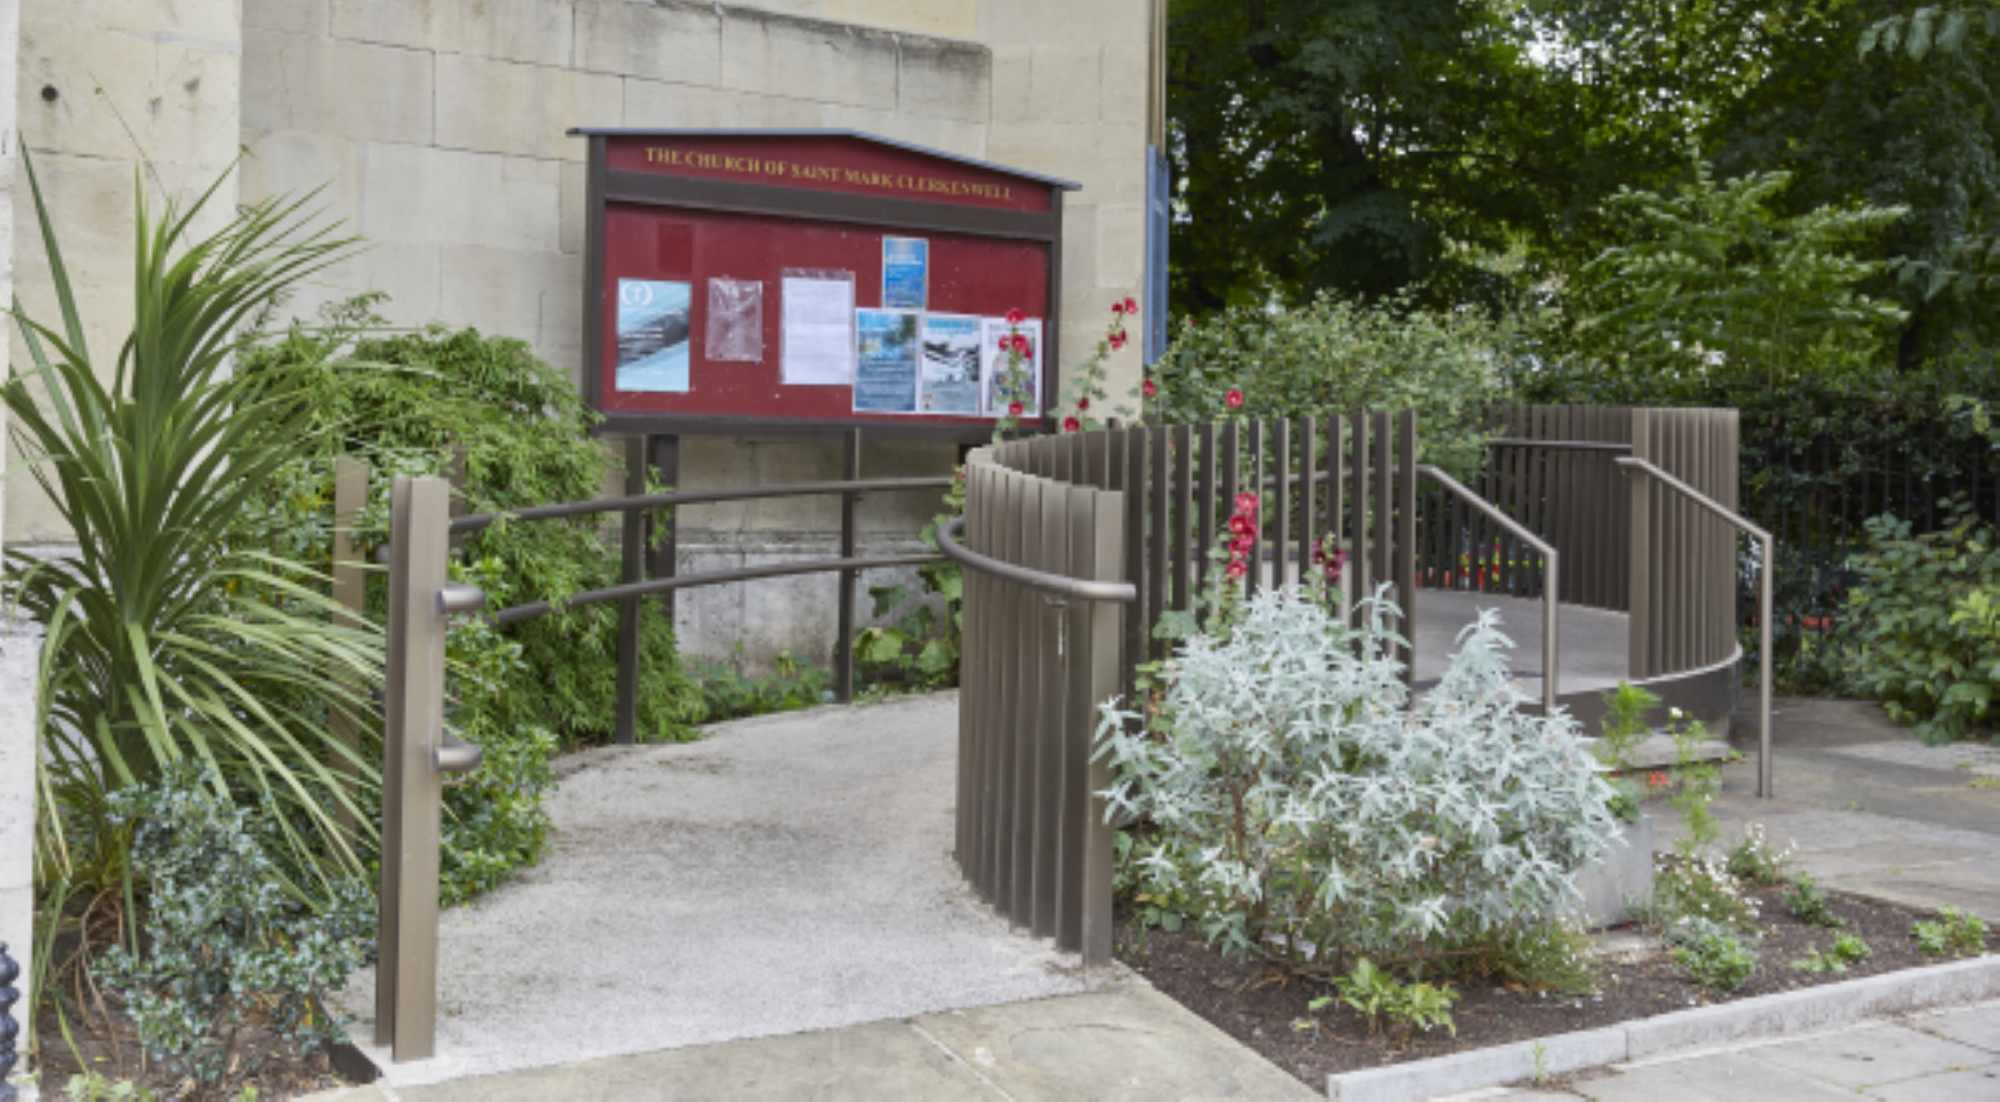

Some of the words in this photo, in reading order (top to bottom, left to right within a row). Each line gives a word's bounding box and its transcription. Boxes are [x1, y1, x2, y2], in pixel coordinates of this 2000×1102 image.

[645, 147, 682, 165] THE
[685, 151, 760, 174] CHURCH
[764, 160, 788, 176] OF
[791, 163, 839, 182] SAINT
[844, 168, 893, 188] MARK
[897, 174, 1014, 201] CLERKENWELL
